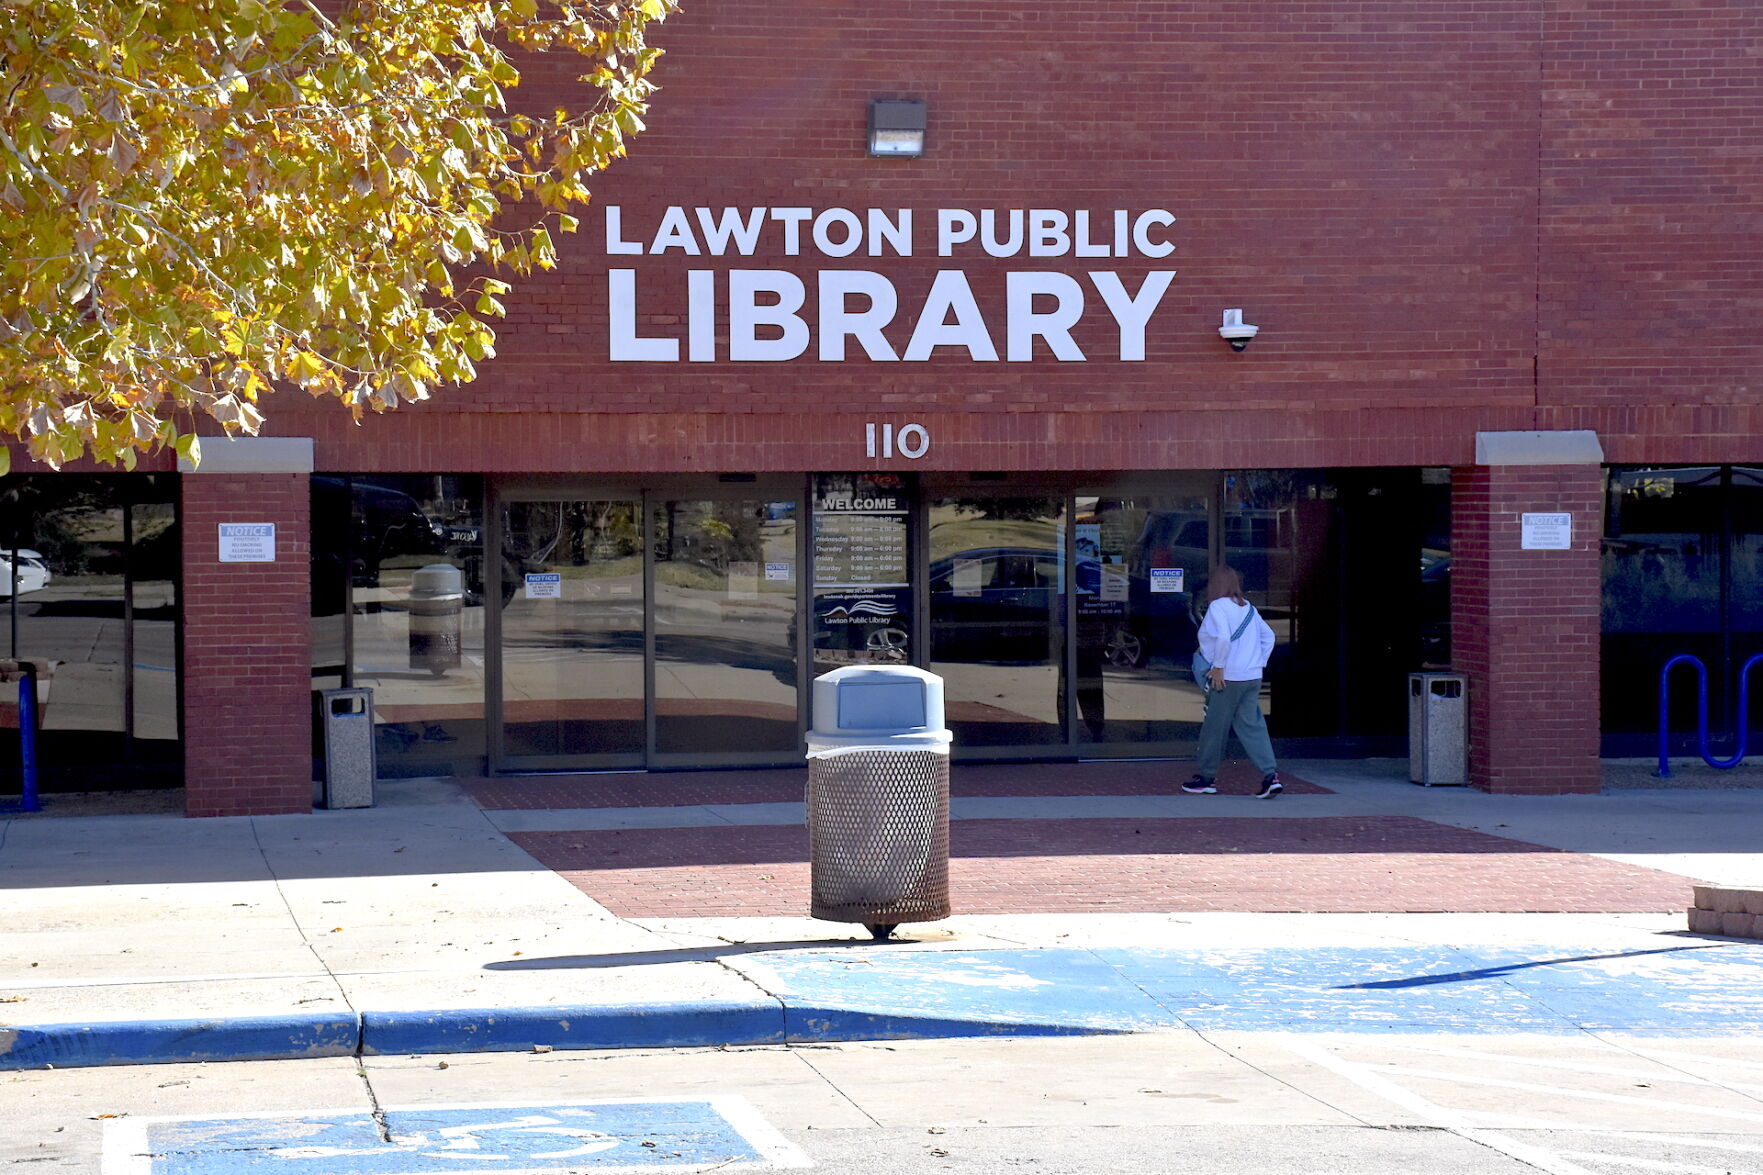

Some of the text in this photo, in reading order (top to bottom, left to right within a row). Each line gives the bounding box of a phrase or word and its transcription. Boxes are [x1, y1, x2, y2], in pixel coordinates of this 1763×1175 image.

[605, 205, 1177, 258] LAWTON PUBLIC
[608, 268, 1177, 362] LIBRARY
[865, 423, 930, 459] 110
[821, 498, 897, 510] WELCOME
[1529, 516, 1565, 525] NOTICE
[226, 526, 267, 536] NOTICE
[868, 617, 891, 625] Library
